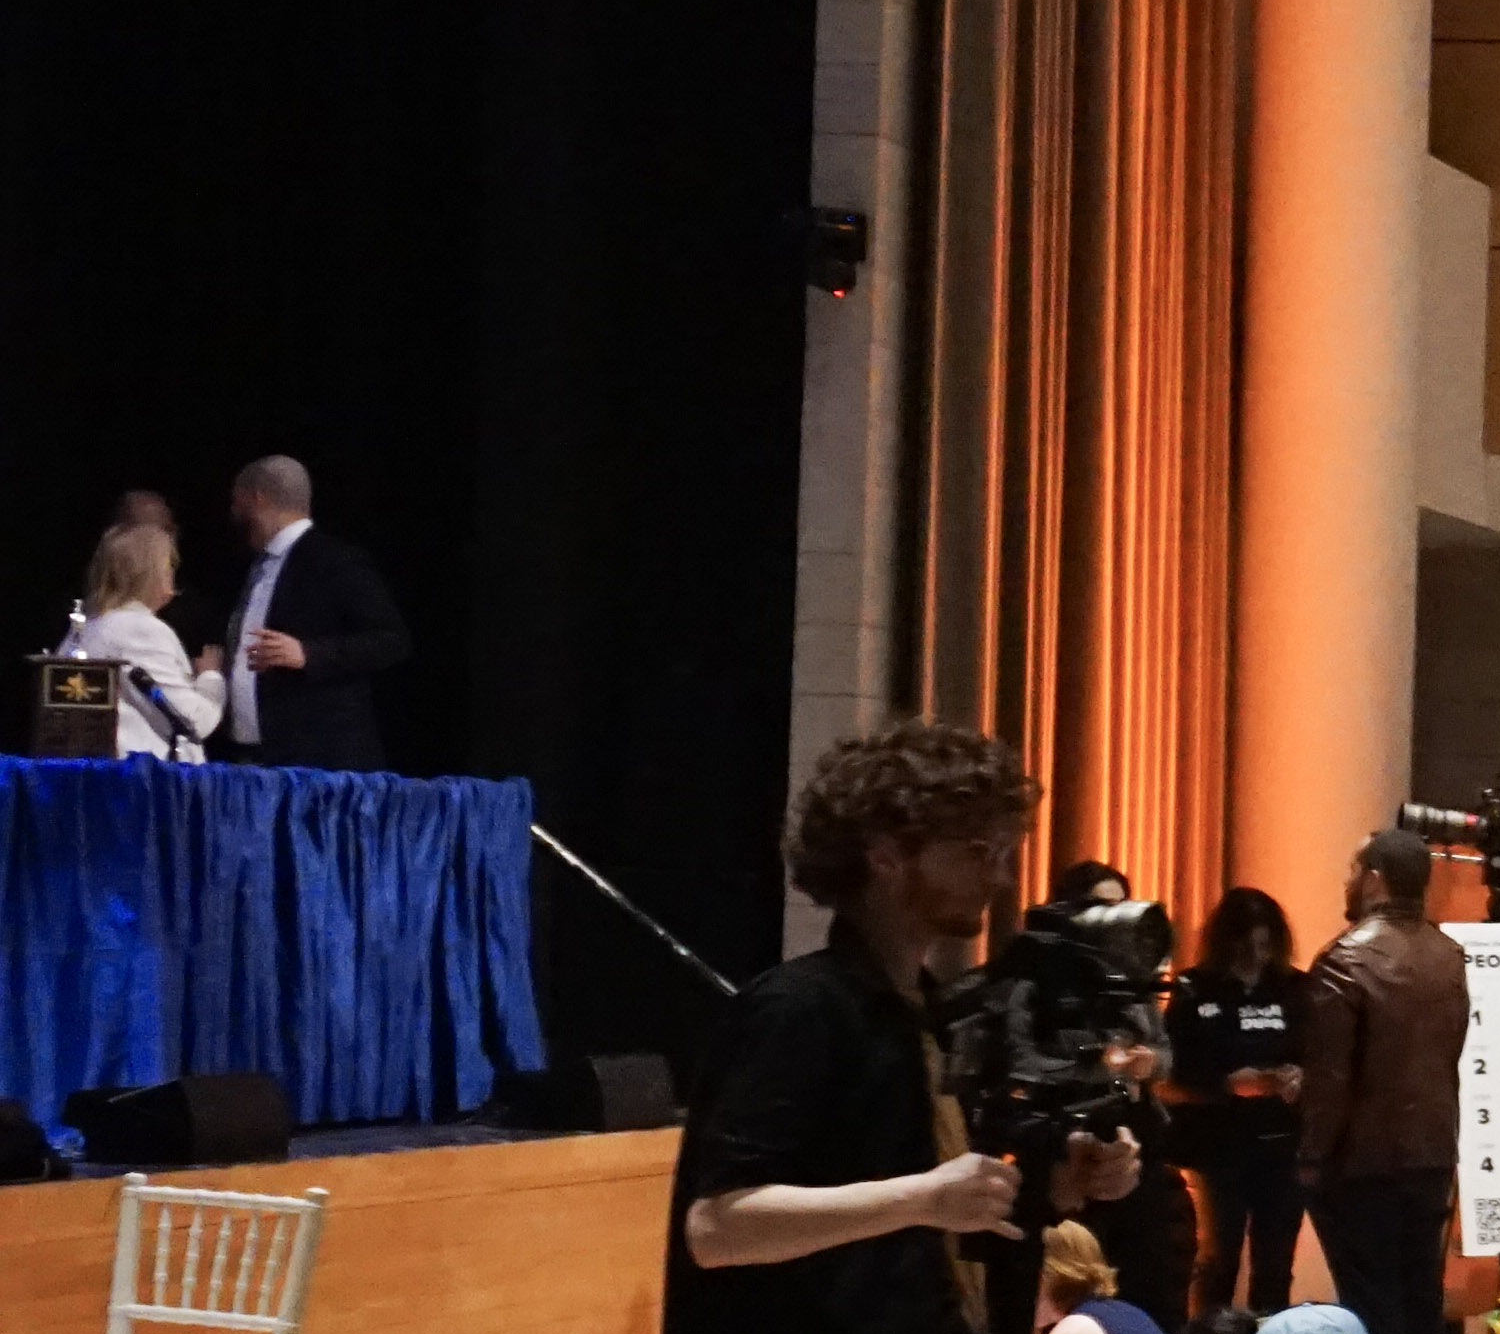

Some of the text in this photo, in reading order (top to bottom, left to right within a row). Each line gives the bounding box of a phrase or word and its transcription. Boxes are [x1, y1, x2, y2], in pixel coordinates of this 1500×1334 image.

[1472, 1058, 1487, 1075] 2
[1476, 1108, 1491, 1125] 3
[1480, 1156, 1495, 1173] 4
